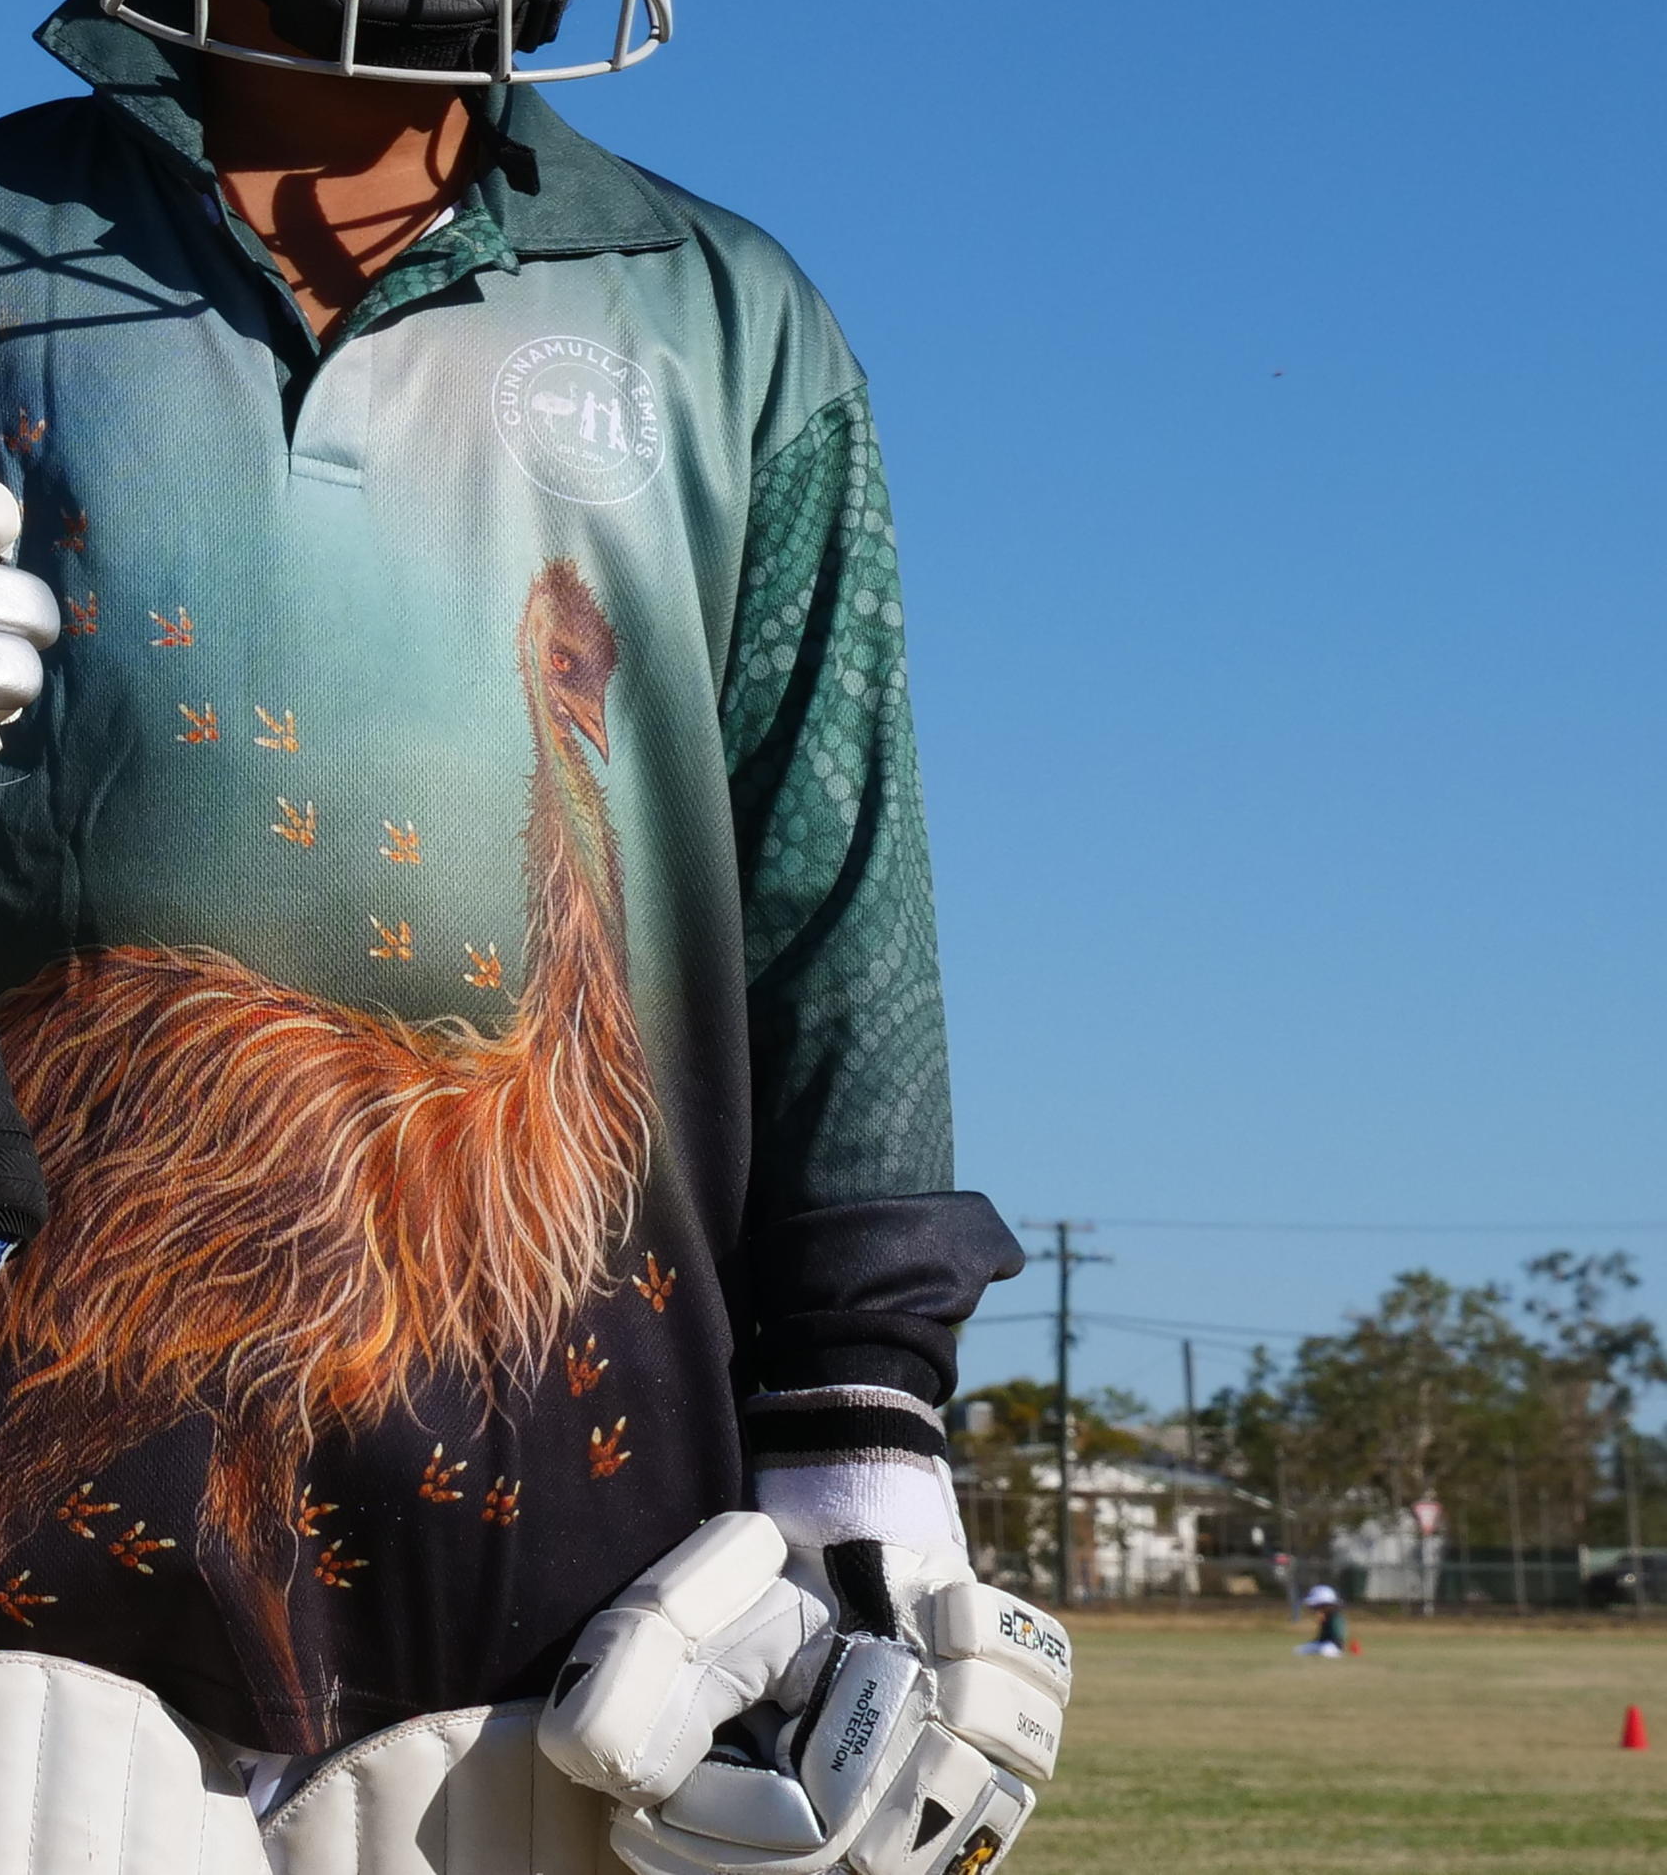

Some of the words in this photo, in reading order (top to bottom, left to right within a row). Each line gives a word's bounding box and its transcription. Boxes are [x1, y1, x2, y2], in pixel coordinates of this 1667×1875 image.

[499, 341, 629, 426] CUNNAMULLA
[631, 385, 658, 459] EMUS
[830, 1679, 878, 1773] PROTECTION
[851, 1708, 880, 1757] EXTRA
[1017, 1711, 1047, 1748] SKIPPY
